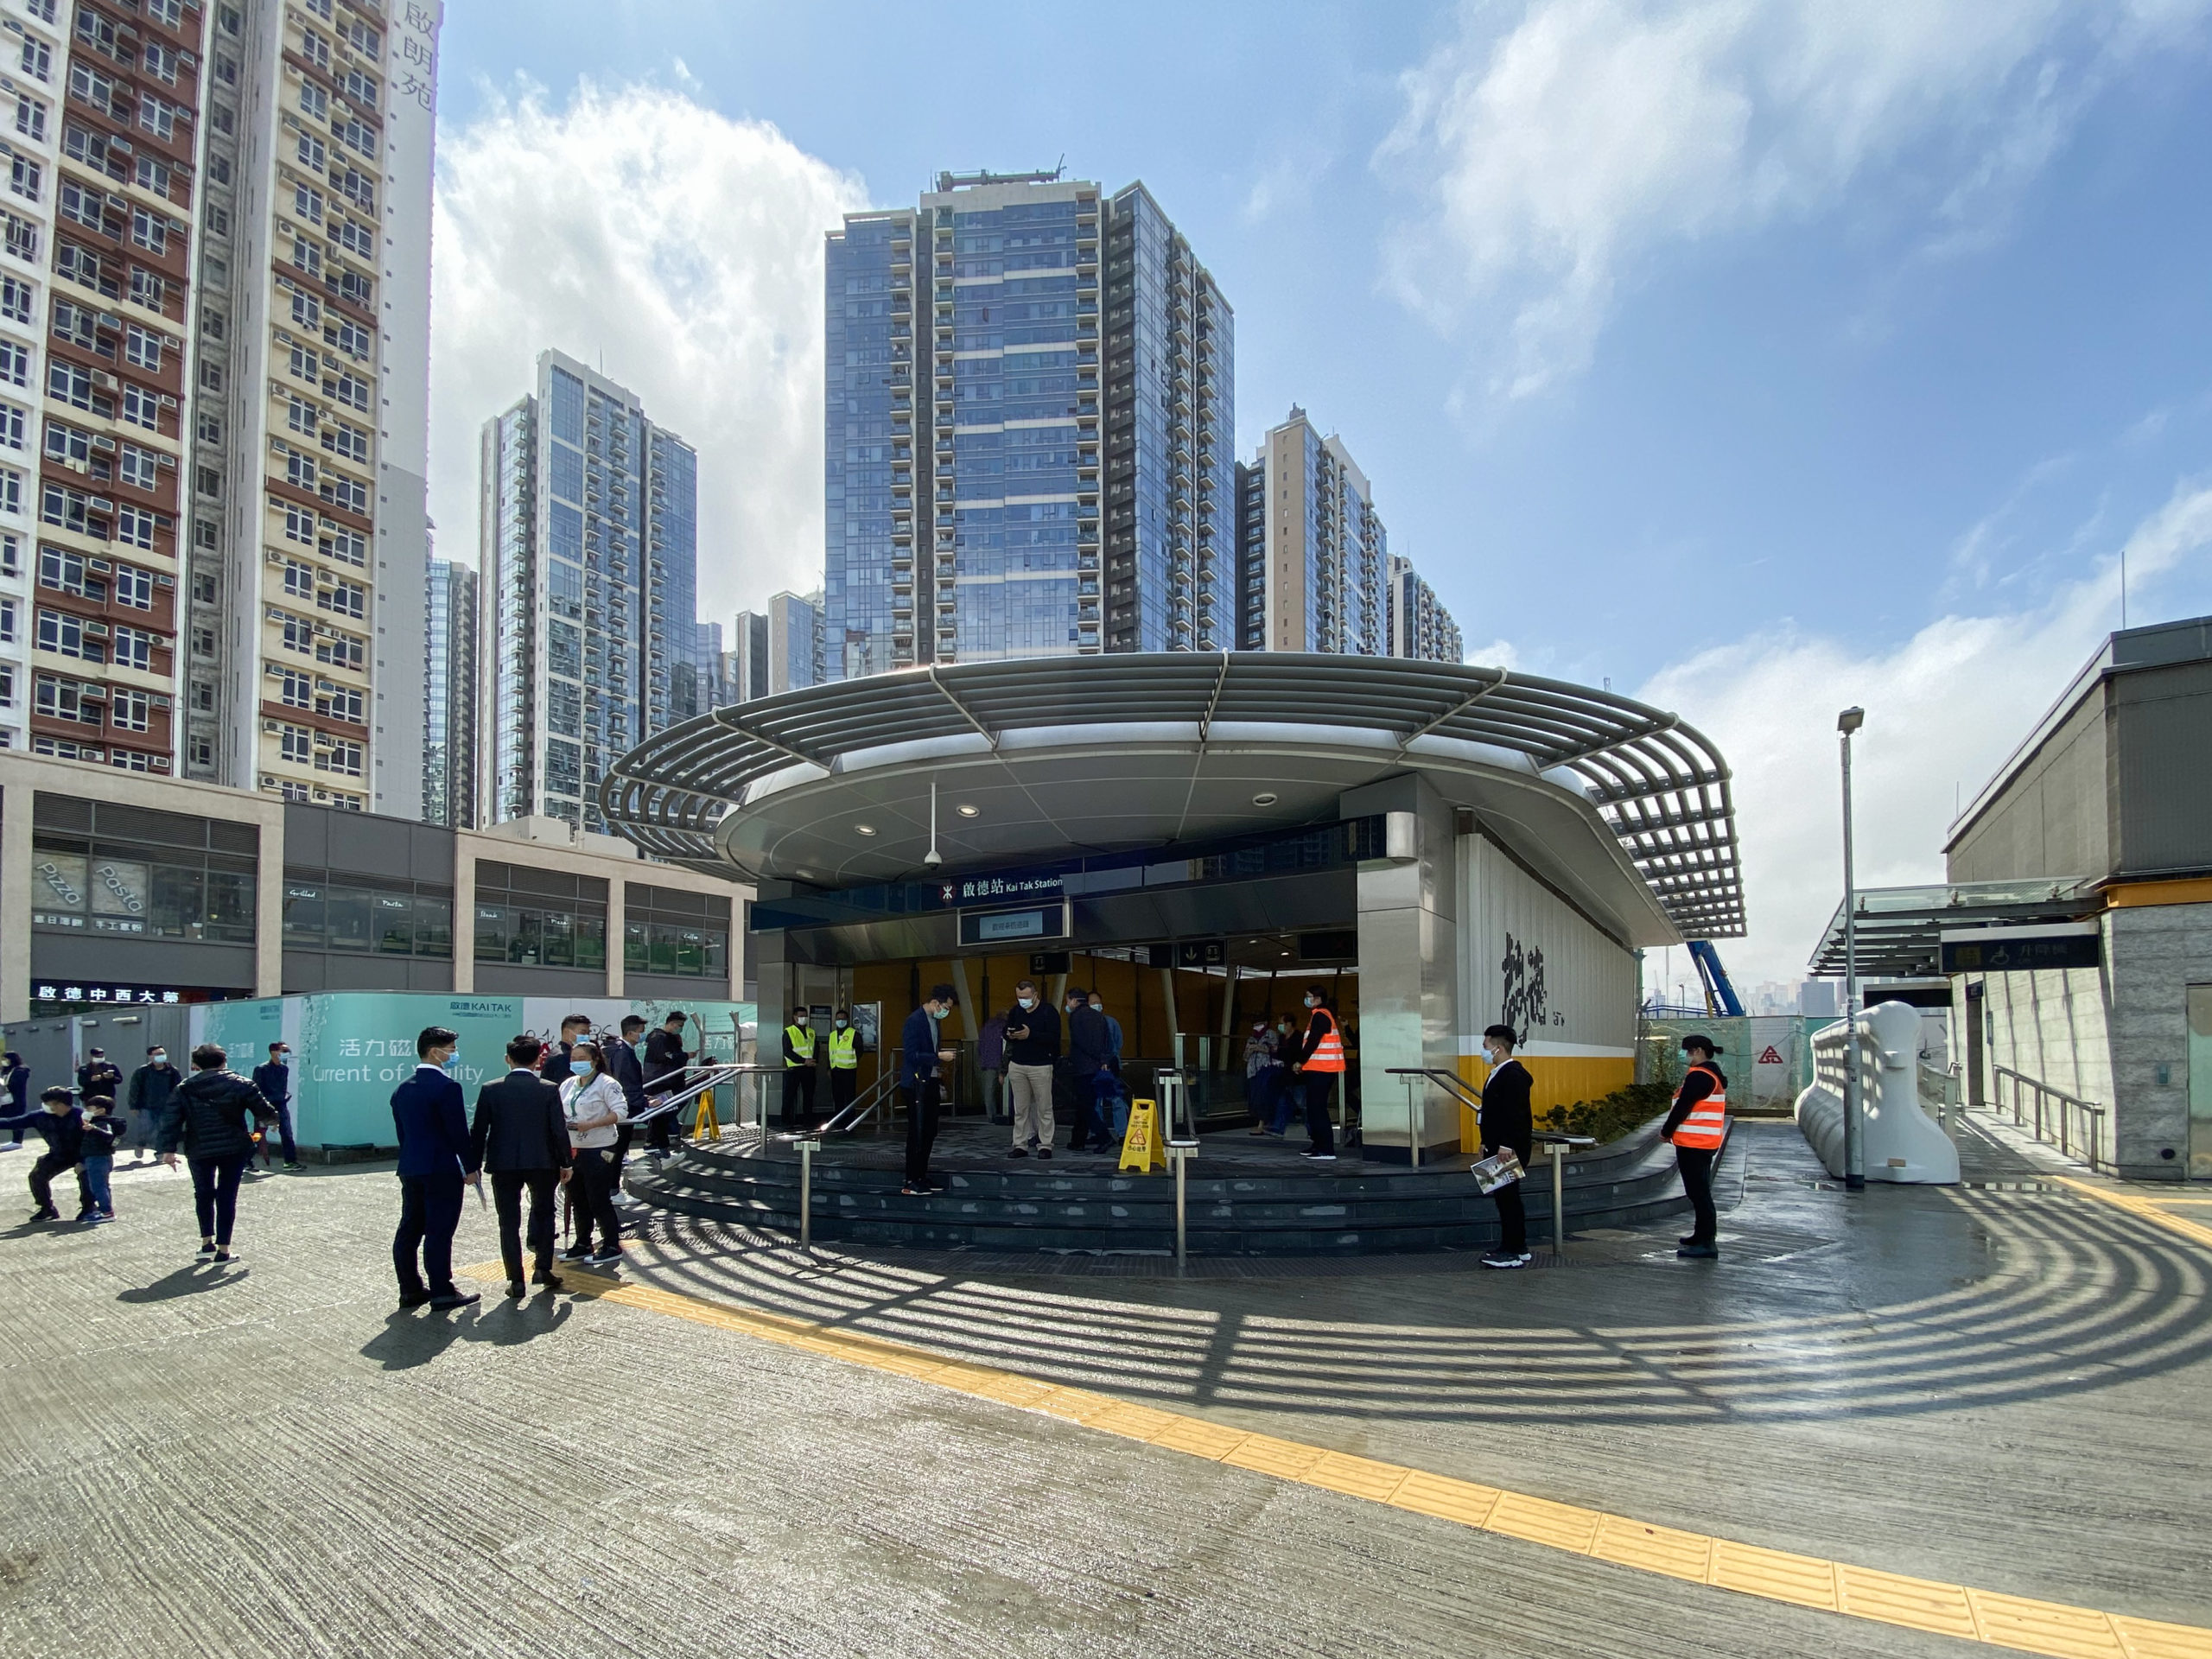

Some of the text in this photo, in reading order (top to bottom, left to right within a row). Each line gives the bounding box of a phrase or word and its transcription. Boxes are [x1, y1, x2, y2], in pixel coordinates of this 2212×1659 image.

[37, 862, 81, 904] Pizza
[95, 866, 143, 912] Pasta
[963, 878, 1063, 898] 啟德站 Kai Tak Station
[38, 986, 179, 1003] 啟德中西大藥
[340, 1039, 418, 1057] 活力磁
[379, 1063, 405, 1082] of
